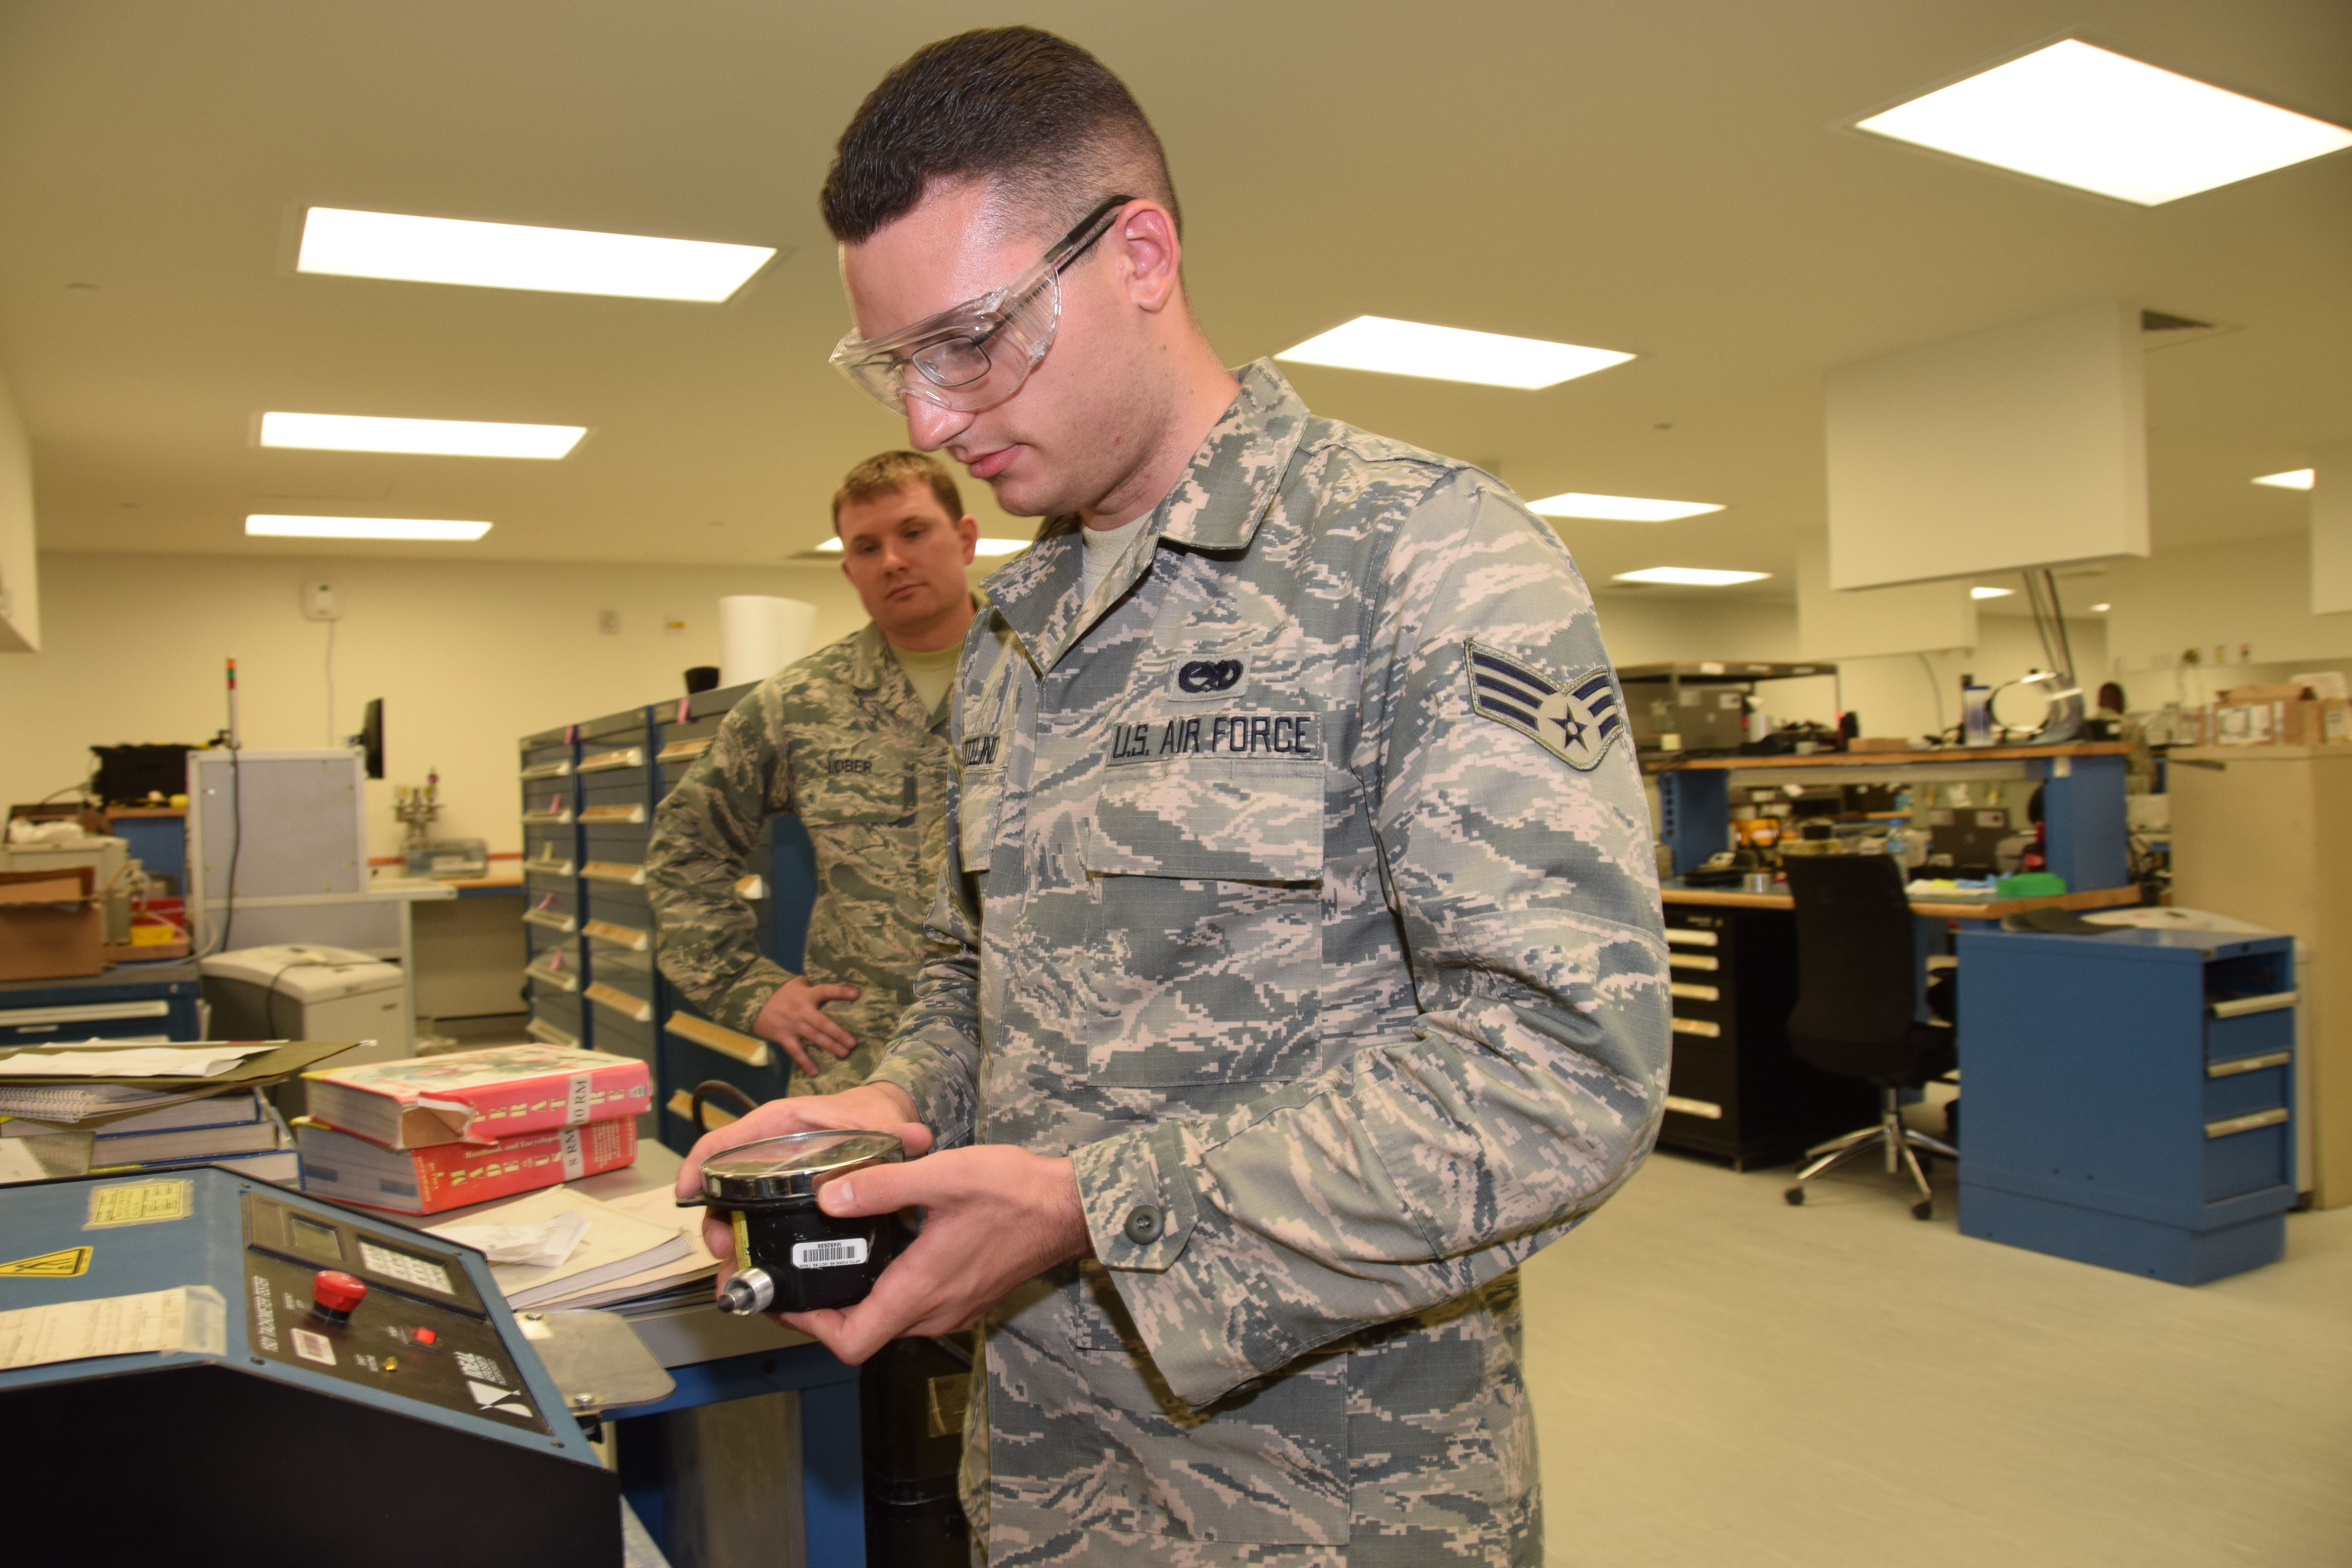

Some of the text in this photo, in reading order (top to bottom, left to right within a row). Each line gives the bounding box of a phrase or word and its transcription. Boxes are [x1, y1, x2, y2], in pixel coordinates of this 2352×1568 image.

[1112, 716, 1311, 758] U.S. AIR FORCE
[574, 1081, 587, 1104] RM
[466, 1145, 503, 1159] Handbook
[564, 1129, 579, 1167] 8 RM
[252, 1275, 271, 1298] TESTER
[256, 1296, 277, 1338] TACHOMETER
[454, 1351, 486, 1380] IDEAL
